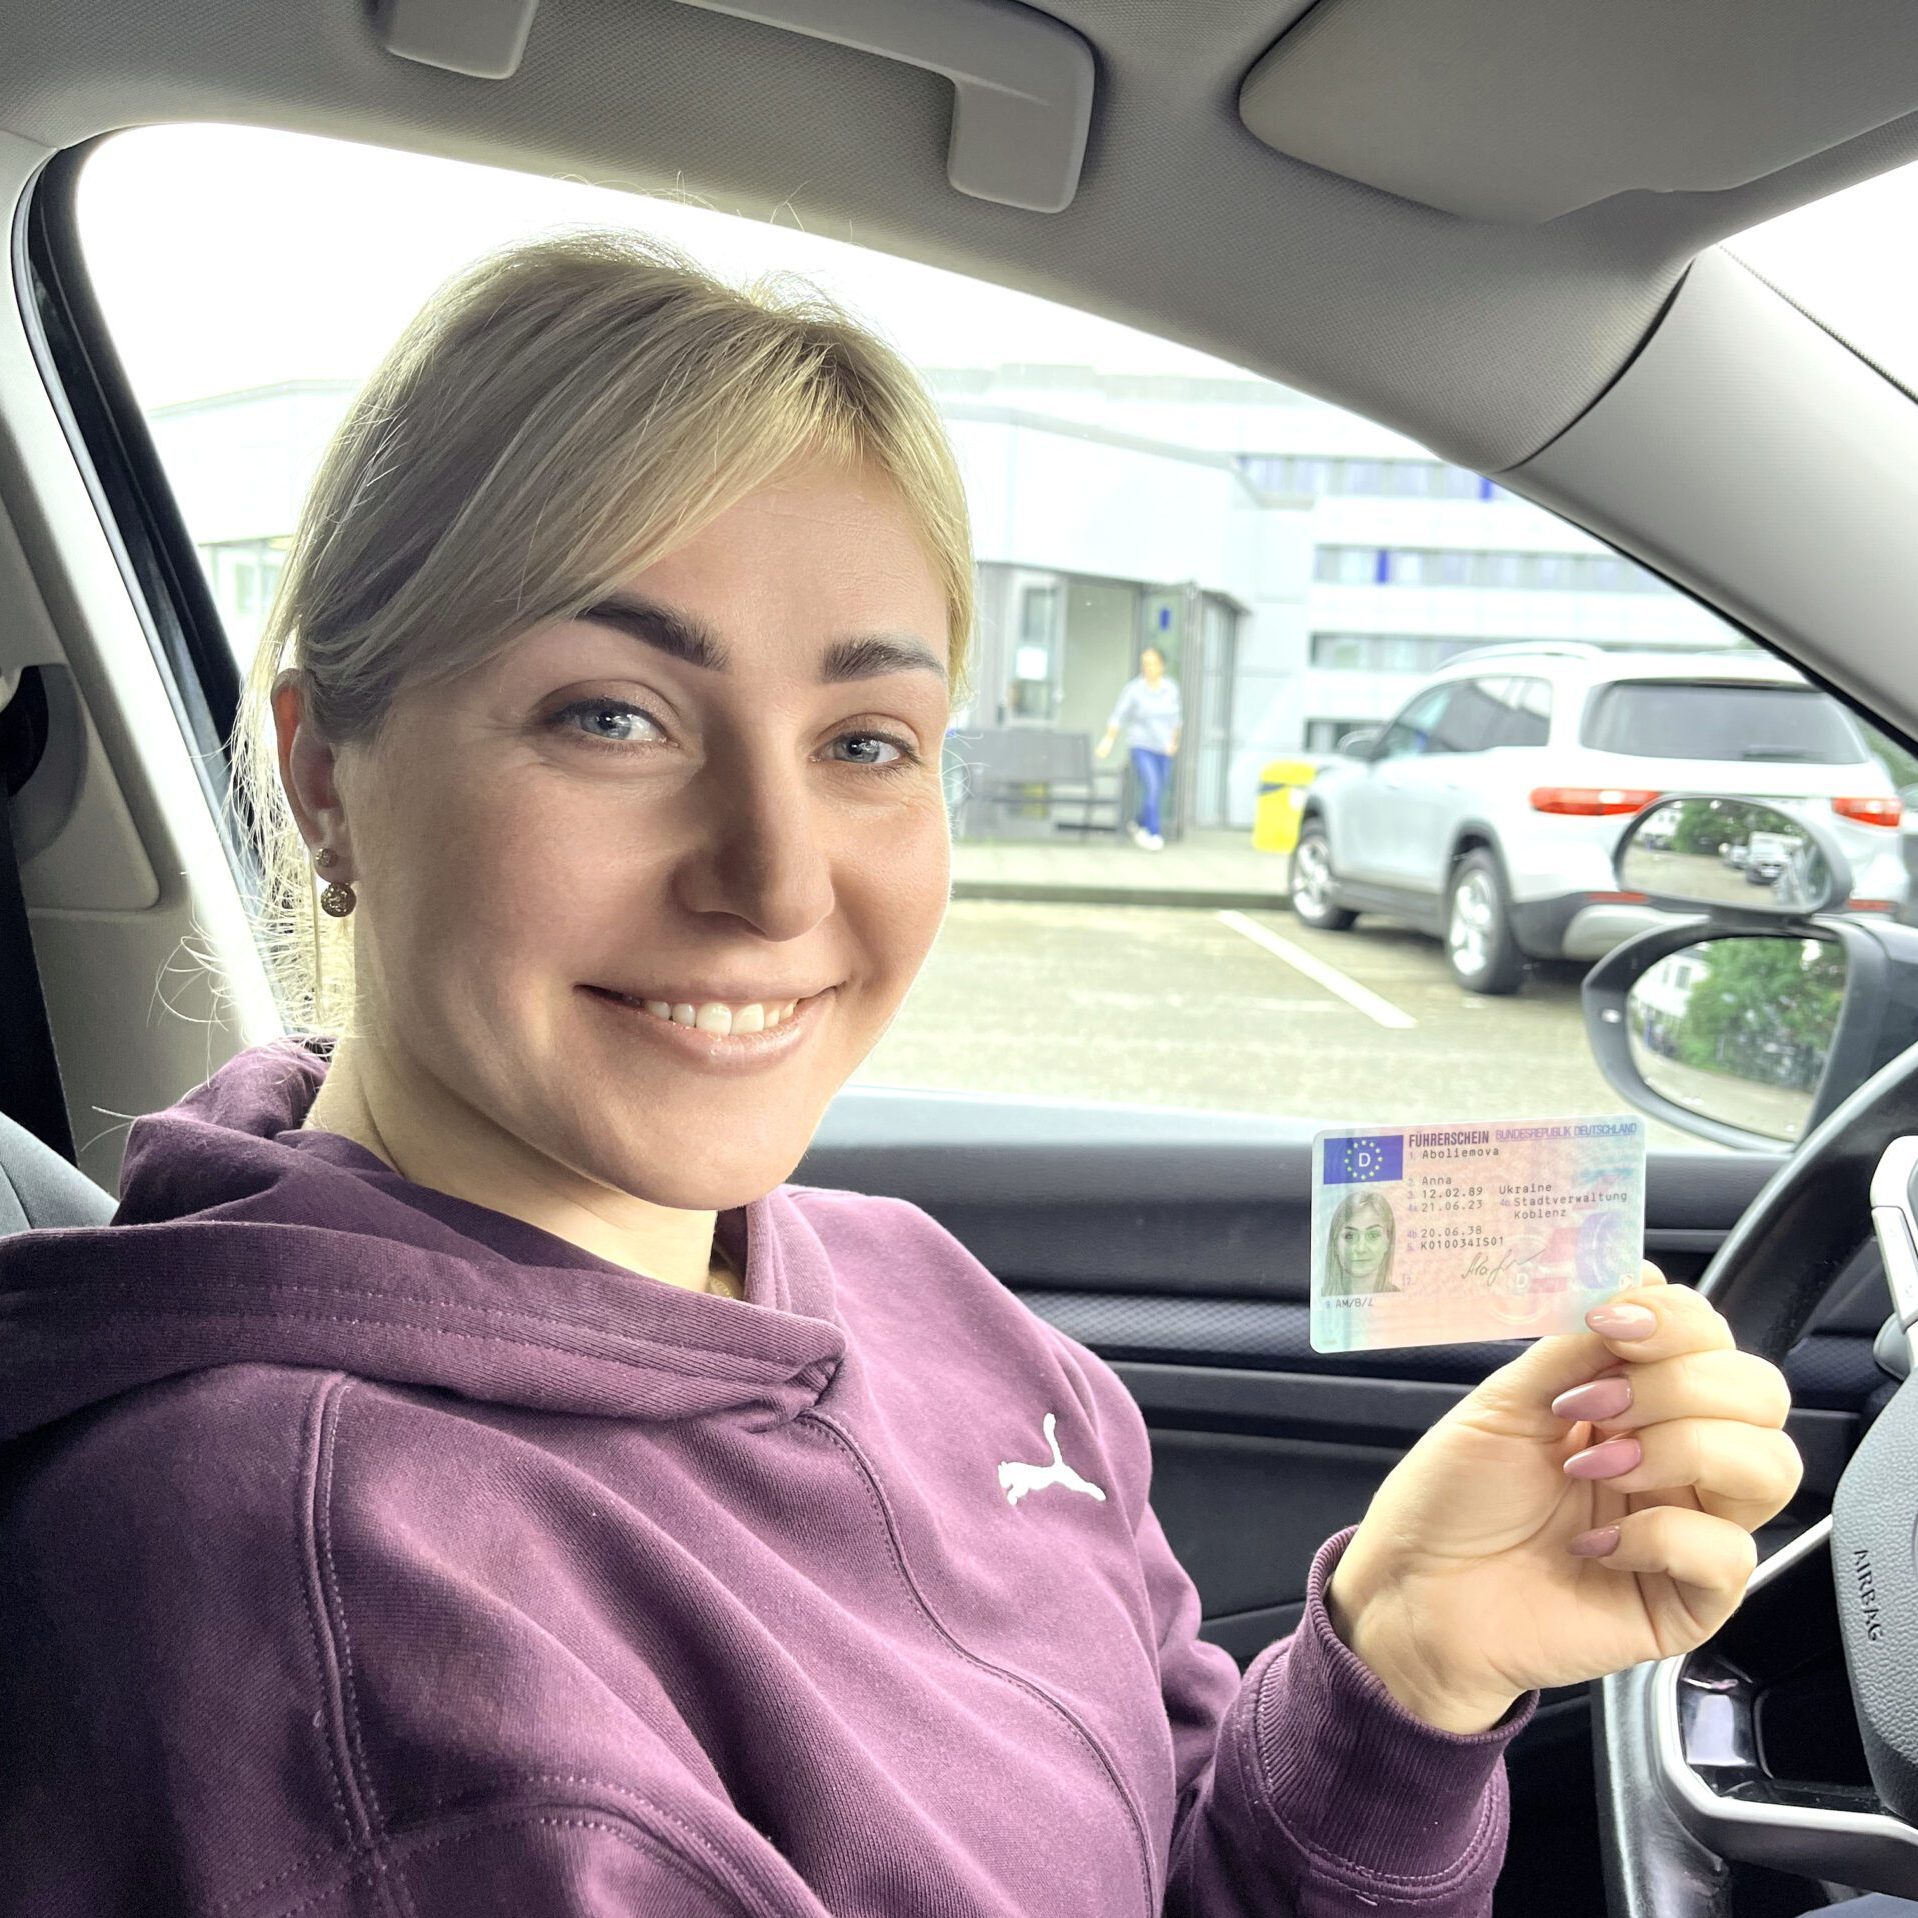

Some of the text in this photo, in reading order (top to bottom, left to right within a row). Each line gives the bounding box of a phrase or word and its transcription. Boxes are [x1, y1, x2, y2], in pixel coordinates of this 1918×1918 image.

[1409, 1123, 1637, 1148] FÜHRERSCHEIN BUNDESREPUBLIK DEUTSCHLAND
[1358, 1153, 1371, 1167] D
[1422, 1148, 1499, 1159] Aboliemova
[1422, 1176, 1452, 1185] Anna
[1422, 1186, 1483, 1199] 12.02.89
[1499, 1183, 1552, 1195] Ukraine
[1421, 1199, 1483, 1212] 21.06.23
[1514, 1192, 1628, 1207] Stadtverwaltung
[1514, 1208, 1567, 1219] Koblenz
[1421, 1225, 1482, 1238] 20.06.38
[1853, 1549, 1884, 1642] AIRBAG
